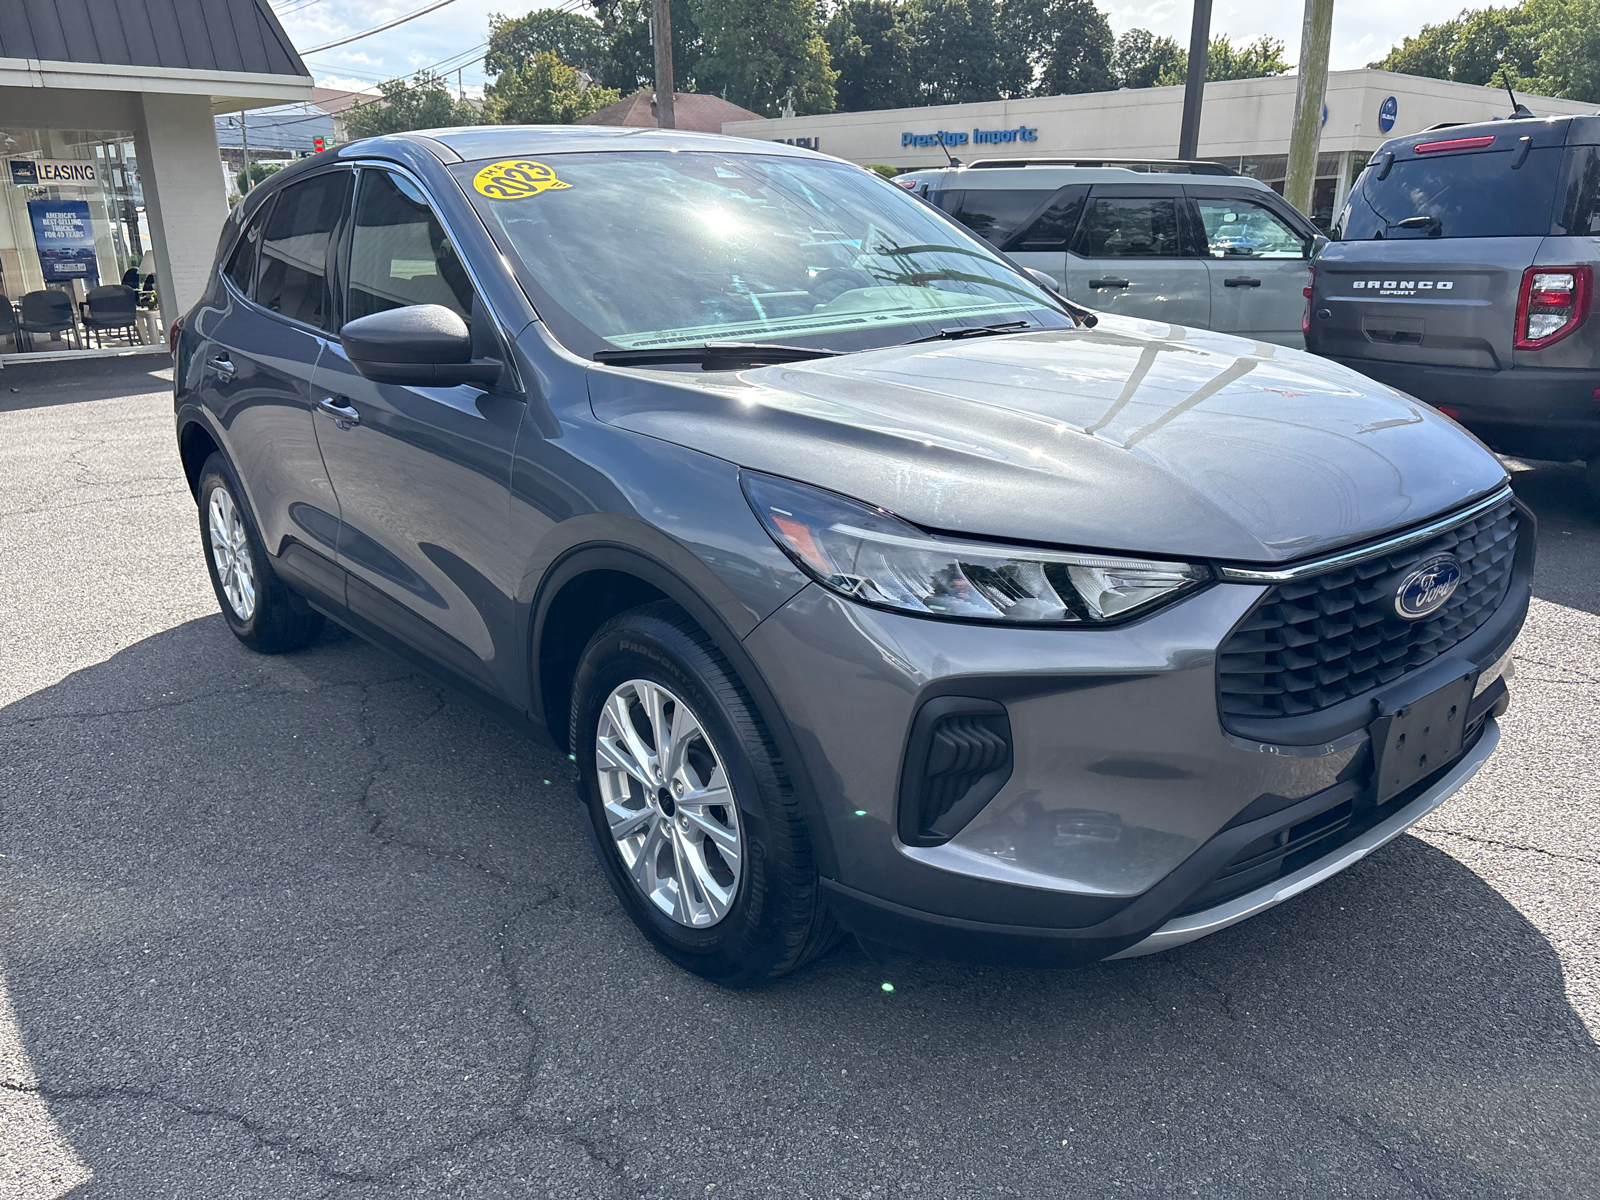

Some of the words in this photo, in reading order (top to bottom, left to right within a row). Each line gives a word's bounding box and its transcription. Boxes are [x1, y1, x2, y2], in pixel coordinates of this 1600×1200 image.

[901, 130, 969, 147] Prestige
[973, 125, 1038, 144] Imports
[37, 164, 96, 180] LEASING
[483, 162, 552, 197] 2023
[1352, 280, 1454, 290] BRONCO
[1415, 569, 1453, 608] Ford
